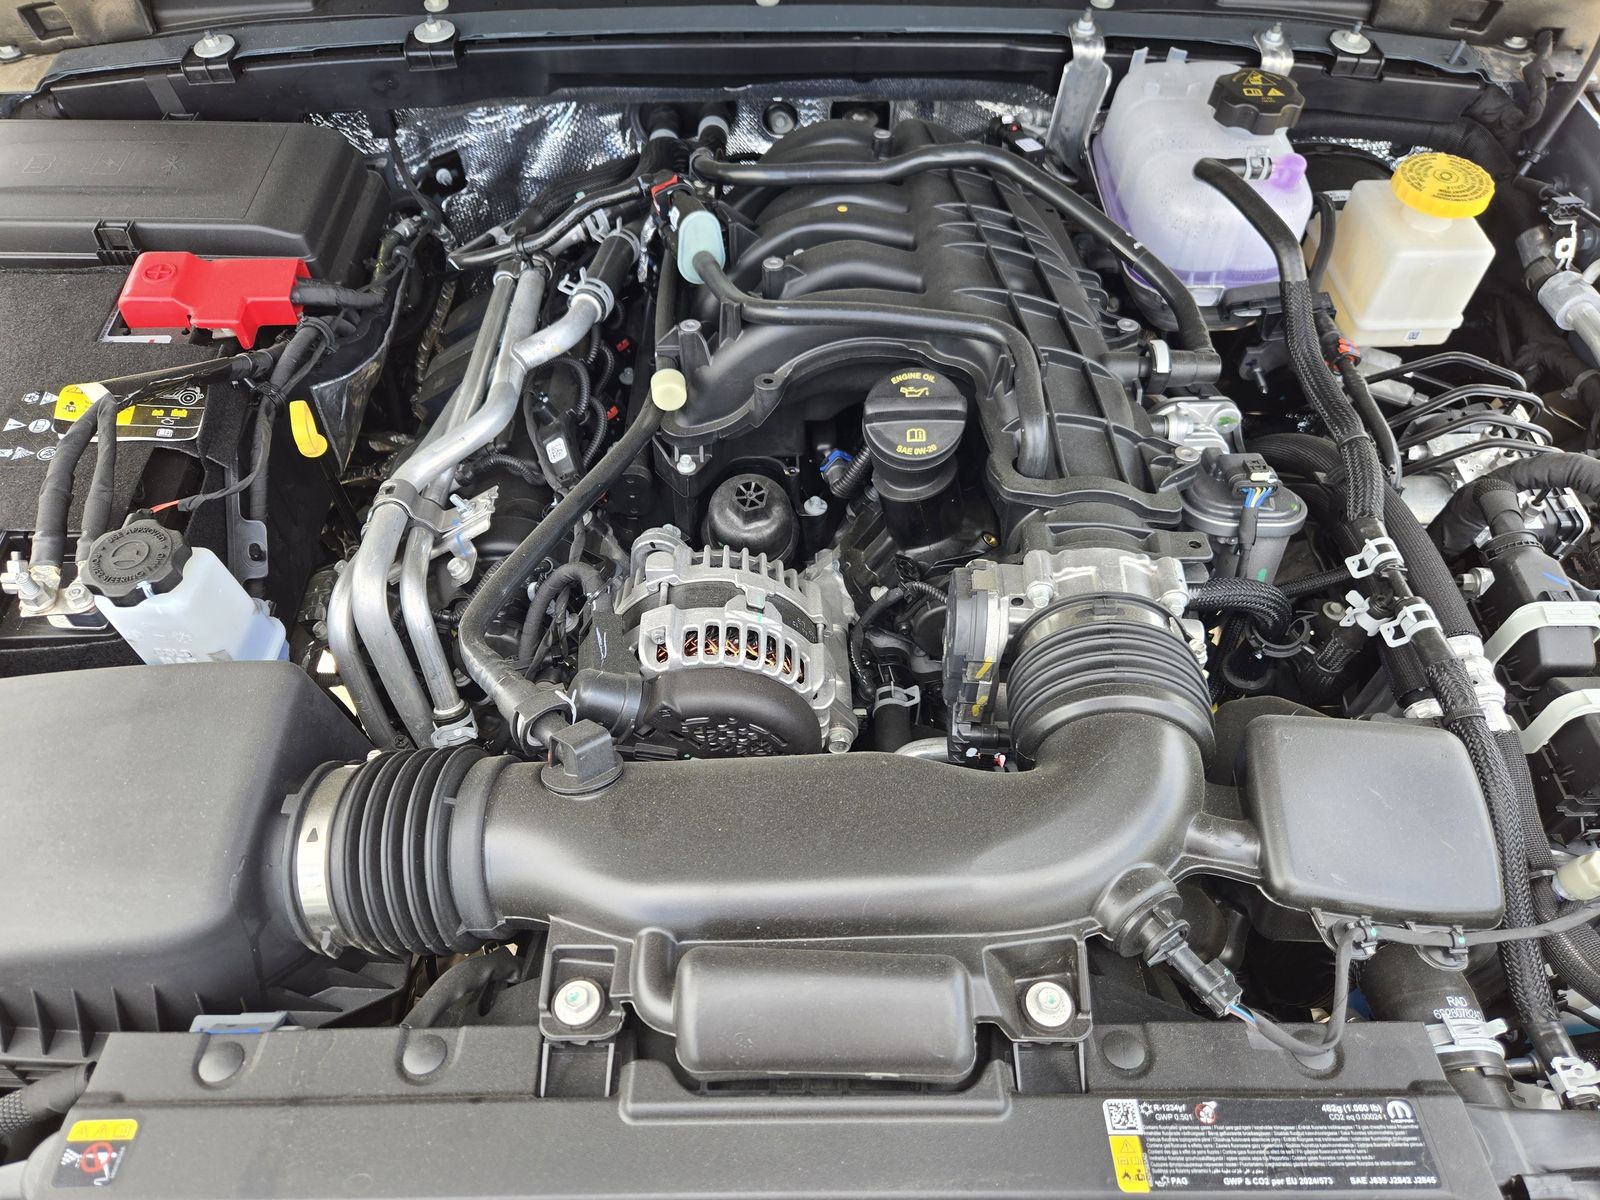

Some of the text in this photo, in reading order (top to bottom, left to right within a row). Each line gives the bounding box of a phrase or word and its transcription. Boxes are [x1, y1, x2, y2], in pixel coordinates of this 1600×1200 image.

[891, 372, 936, 384] ENGINE OIL
[896, 443, 937, 455] SAE 0W-20
[126, 527, 167, 542] APPROVED
[1446, 996, 1468, 1007] RAD
[1153, 1104, 1186, 1113] R-1234yf
[1321, 1104, 1343, 1114] 482g
[1370, 1103, 1382, 1113] lb)
[1155, 1113, 1193, 1121] GWP 0.501
[1328, 1113, 1345, 1121] CO2
[1170, 1177, 1189, 1186] PAG
[1223, 1177, 1243, 1186] GWP
[1244, 1177, 1252, 1186] &
[1252, 1177, 1271, 1186] CO2
[1271, 1178, 1285, 1187] per
[1285, 1177, 1298, 1186] EU
[1349, 1176, 1368, 1185] SAE
